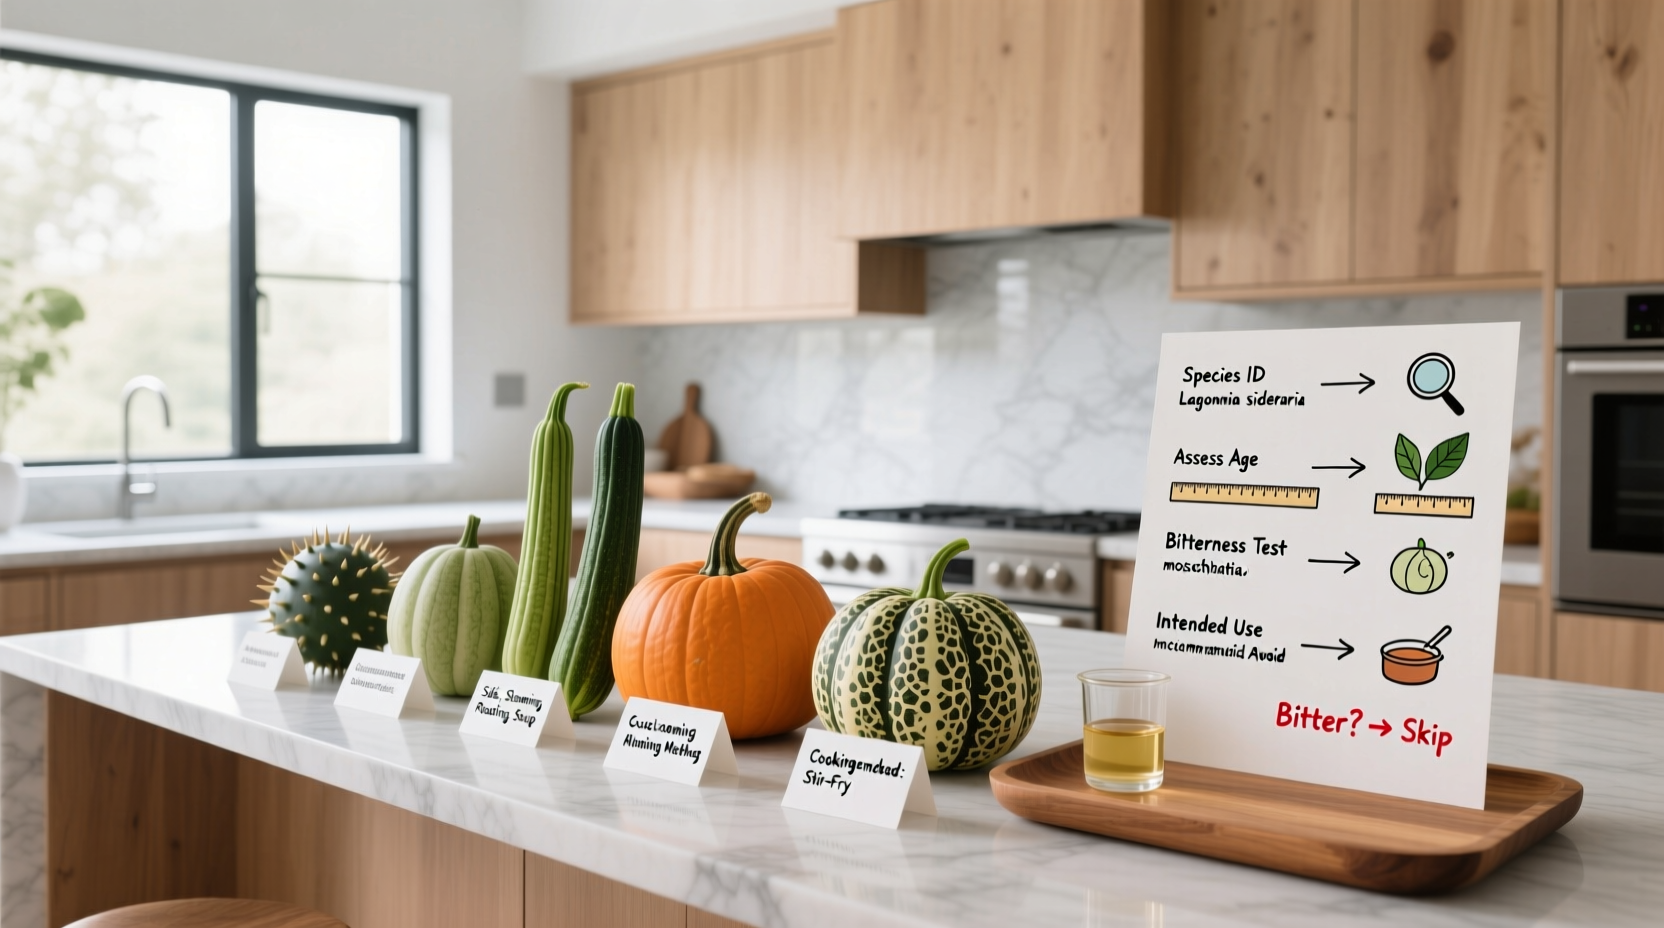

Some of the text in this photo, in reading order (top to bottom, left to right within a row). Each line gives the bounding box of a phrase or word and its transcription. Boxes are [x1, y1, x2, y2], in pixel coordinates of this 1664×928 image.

[1183, 365, 1266, 388] Species ID
[1174, 447, 1259, 472] Assess Age
[1165, 531, 1288, 556] Bitterness Test
[1156, 611, 1263, 637] Intended Use
[1276, 701, 1453, 757] Bitter? Skip
[802, 769, 852, 796] Stir-Fry
